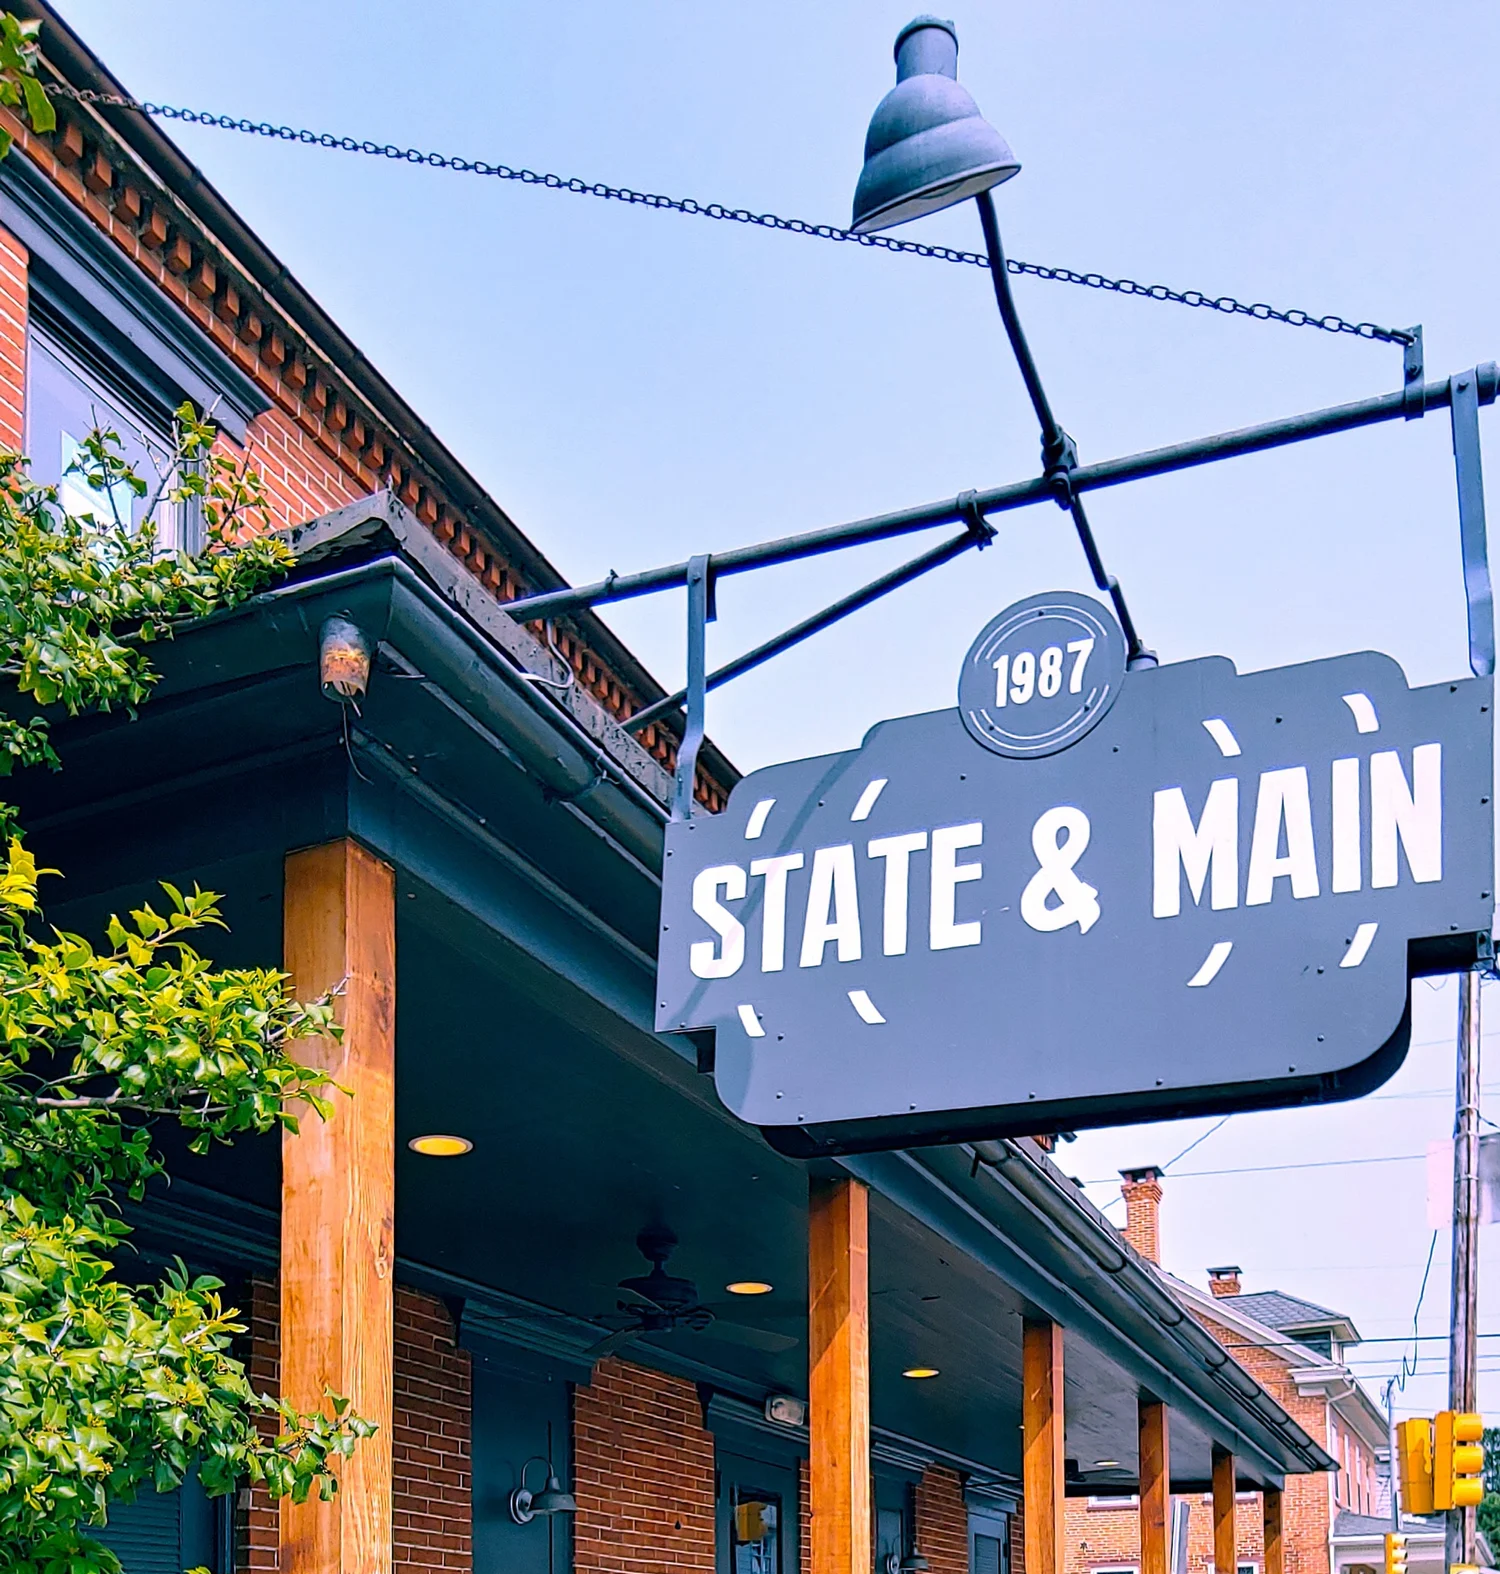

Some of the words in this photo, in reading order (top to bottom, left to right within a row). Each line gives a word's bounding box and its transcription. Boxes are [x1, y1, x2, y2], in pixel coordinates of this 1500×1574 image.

[993, 637, 1094, 708] 1987
[690, 822, 983, 979] STATE
[1020, 806, 1101, 934] &
[1152, 743, 1442, 919] MAIN
